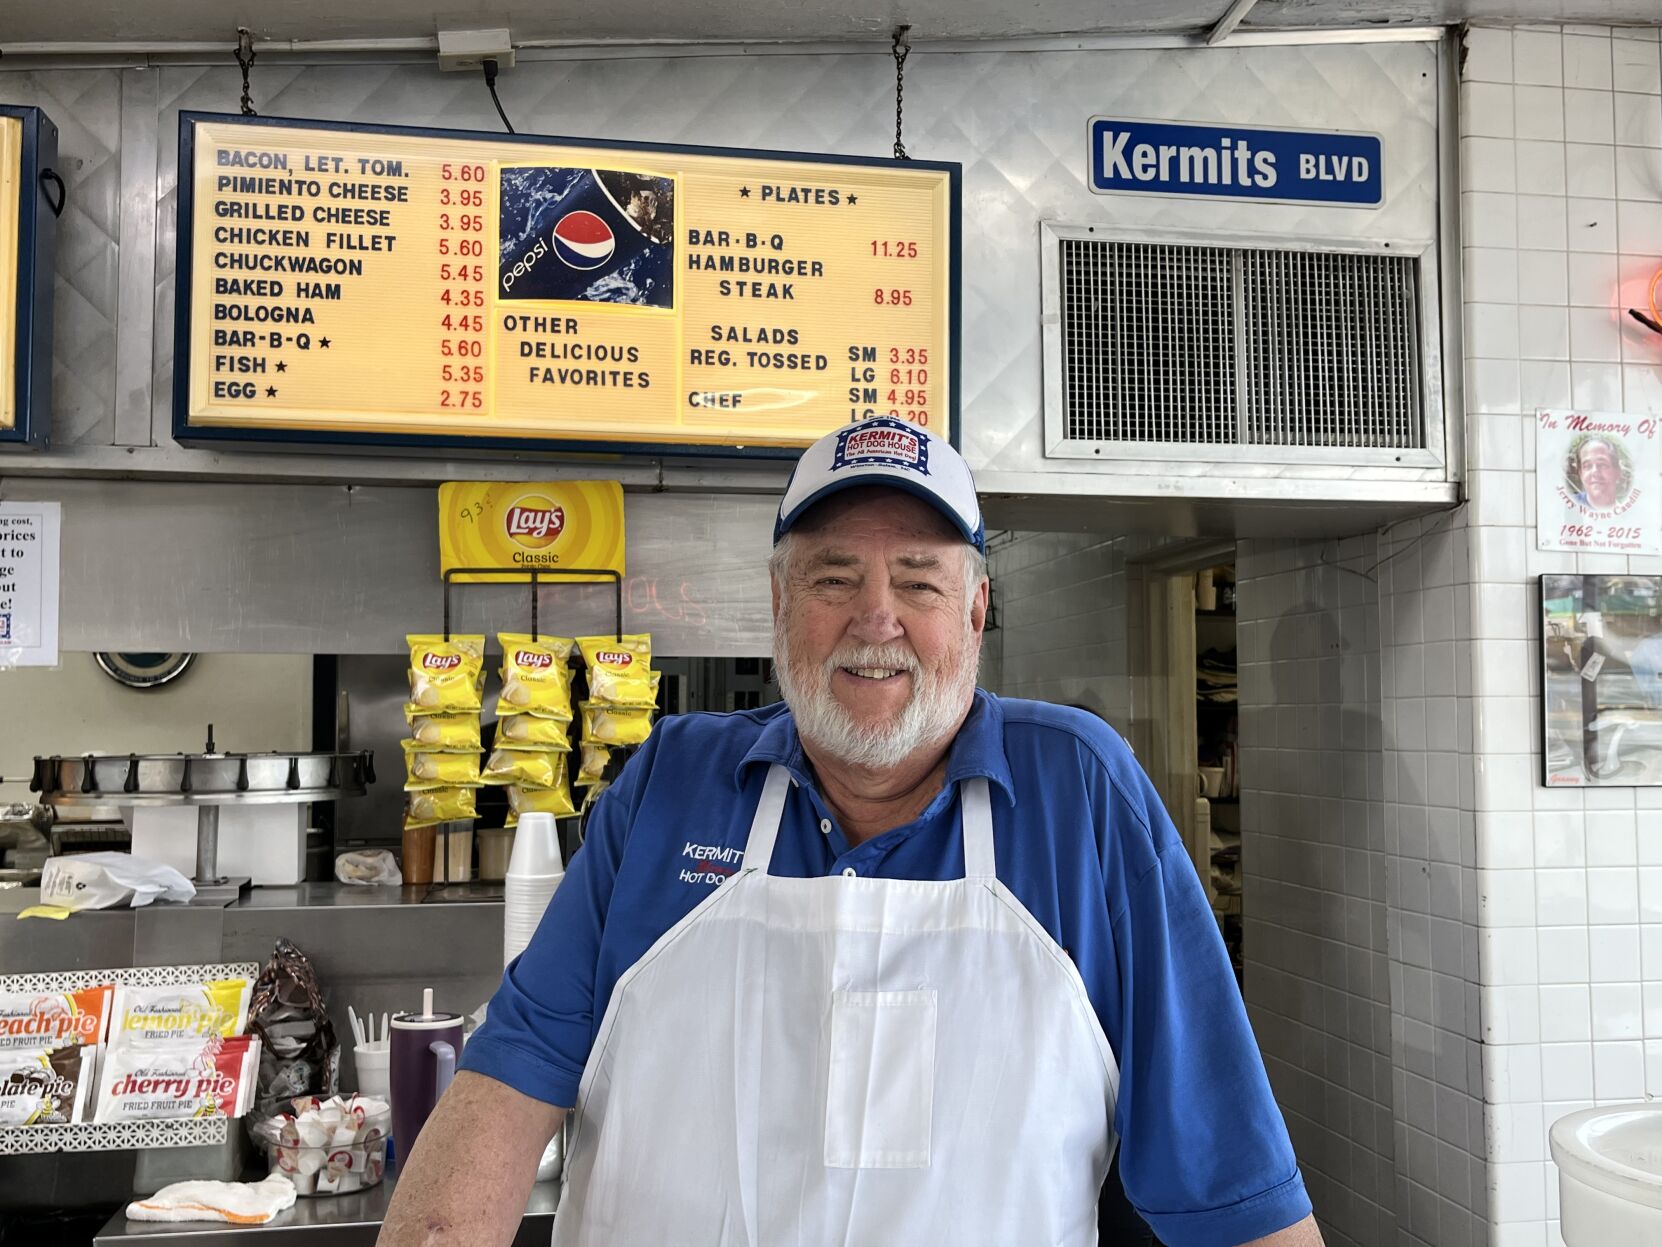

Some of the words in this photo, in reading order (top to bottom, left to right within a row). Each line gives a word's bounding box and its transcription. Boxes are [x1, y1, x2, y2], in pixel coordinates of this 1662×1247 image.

[217, 150, 293, 176] BACON,
[304, 155, 349, 174] LET.
[358, 159, 409, 177] TOM.
[441, 164, 485, 183] 5.60
[1103, 131, 1277, 188] Kermits
[1299, 153, 1369, 182] BLVD
[217, 176, 321, 197] PIMIENTO
[328, 182, 409, 202] CHEESE
[440, 189, 483, 207] 3.95
[761, 186, 840, 205] PLATES
[214, 201, 305, 222] GRILLED
[312, 207, 390, 226] CHEESE
[440, 214, 483, 232] 3.95
[214, 227, 309, 248] CHICKEN
[326, 233, 396, 252] FILLET
[439, 239, 483, 257] 5.60
[871, 240, 918, 258] 11.25
[214, 252, 363, 275] CHUCKWAGON
[440, 264, 483, 282] 5.45
[502, 237, 549, 292] pepsi
[688, 254, 824, 277] HAMBURGER
[215, 278, 283, 297] BAKED
[297, 282, 341, 300] HAM
[441, 289, 484, 307] 4.35
[719, 280, 794, 300] STEAK
[874, 289, 912, 306] 8.95
[214, 304, 315, 324] BOLOGNA
[441, 314, 483, 332] 4.45
[503, 315, 578, 334] OTHER
[214, 330, 311, 350] BAR-B-Q
[441, 340, 482, 357] 5.60
[711, 325, 799, 345] SALADS
[520, 341, 639, 362] DELICIOUS
[690, 349, 737, 367] REG.
[747, 352, 828, 370] TOSSED
[848, 346, 876, 362] SM
[890, 348, 927, 364] 3.35
[215, 355, 267, 373] FISH
[442, 365, 483, 383] 5.35
[529, 367, 650, 388] FAVORITES
[851, 367, 875, 383] LG
[890, 368, 927, 385] 6.10
[214, 382, 256, 399] EGG
[440, 390, 482, 408] 2.75
[688, 391, 742, 409] CHEF
[849, 388, 877, 404] SM
[887, 389, 927, 406] 4.95
[1539, 412, 1558, 429] In
[1565, 415, 1631, 437] Memory
[1637, 418, 1657, 439] Of
[847, 442, 864, 451] HOT
[888, 441, 916, 454] HOUSE
[848, 431, 917, 447] KERMIT'S
[11, 517, 33, 526] cost,
[510, 508, 561, 538] Lay's
[1579, 505, 1612, 520] Wayne
[1560, 524, 1593, 537] 1962
[1607, 527, 1641, 539] 2015
[11, 548, 24, 558] to
[512, 551, 559, 563] Classic
[0, 582, 16, 592] ut
[679, 869, 705, 883] HOT
[56, 1009, 97, 1039] pie
[122, 1008, 191, 1032] lemon
[13, 1036, 37, 1046] FRUIT
[40, 1035, 53, 1044] PIE
[144, 1030, 169, 1039] FRIED
[171, 1030, 185, 1038] PIE
[0, 1079, 42, 1097] late
[41, 1076, 73, 1099] pie
[111, 1073, 191, 1098] cherry
[193, 1071, 235, 1098] pie
[123, 1102, 149, 1111] FRIED
[151, 1100, 177, 1110] FRUIT
[178, 1100, 193, 1109] PIE
